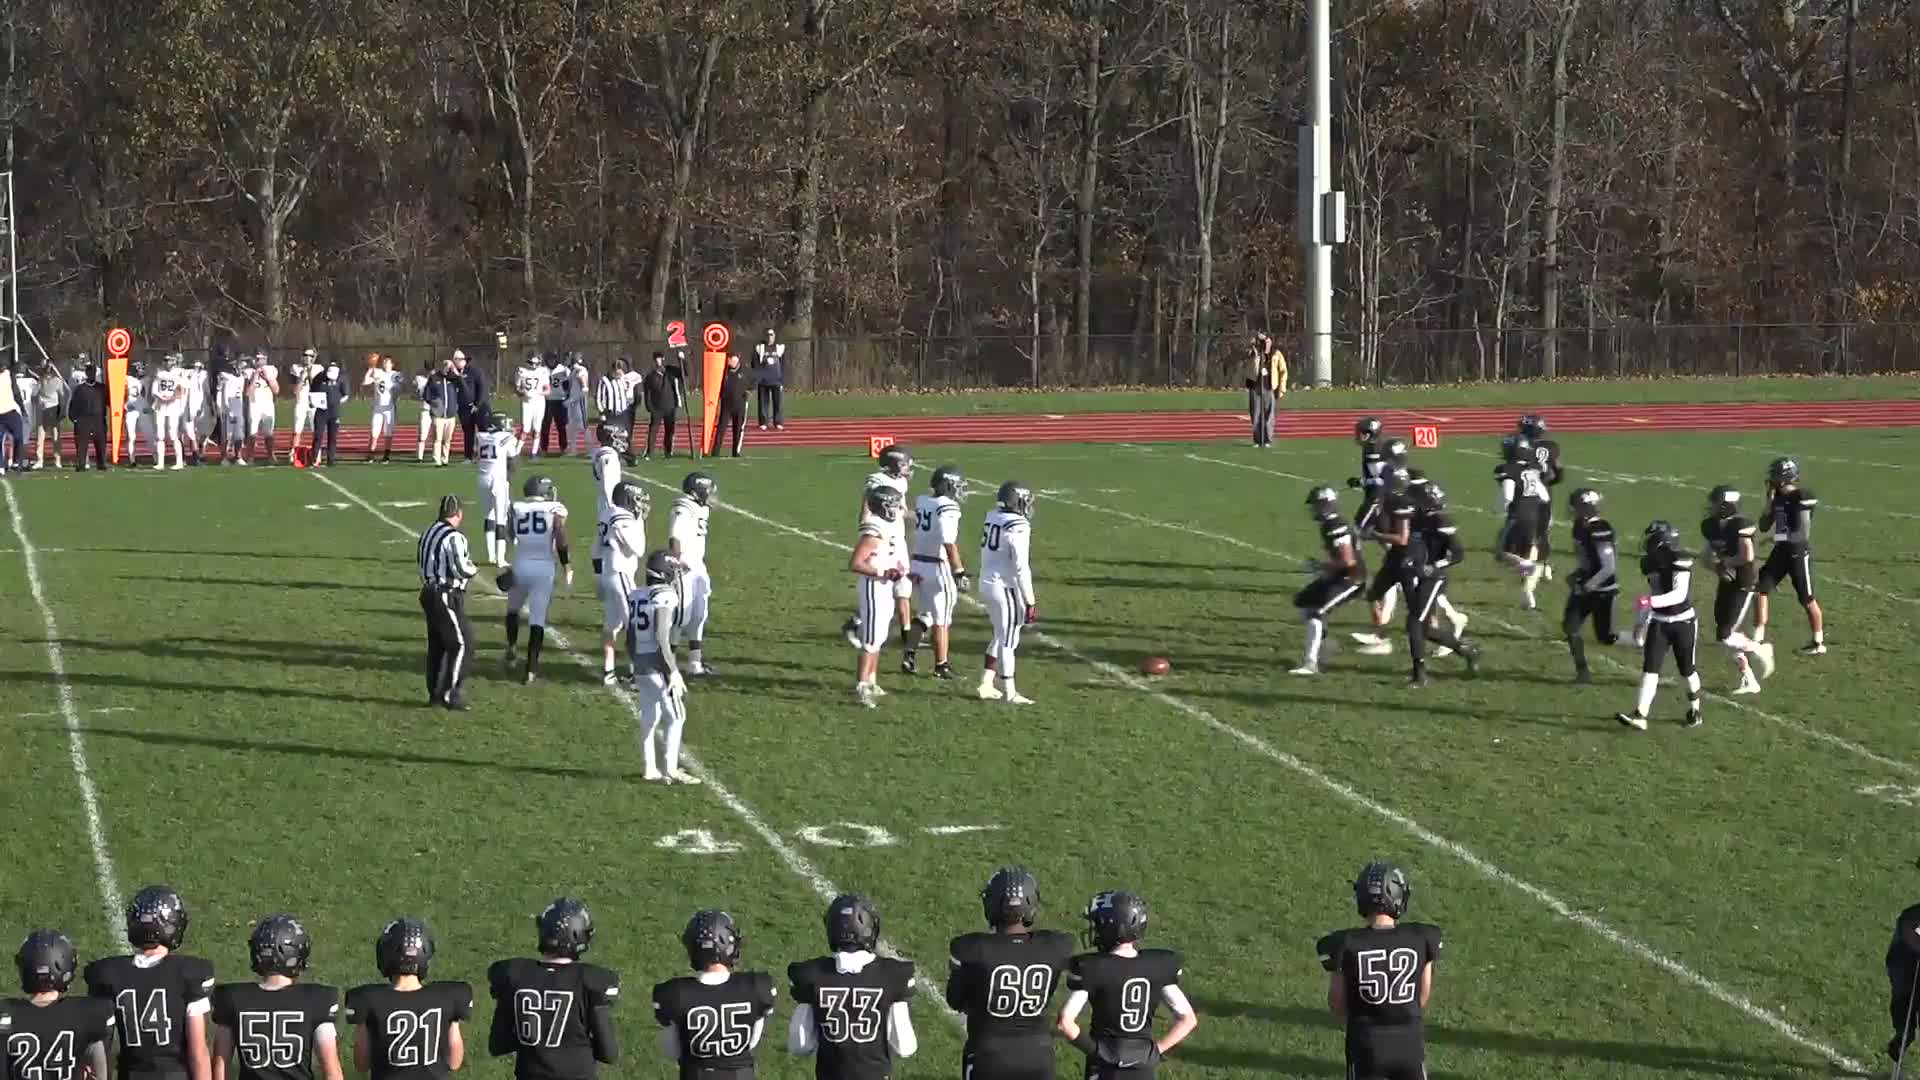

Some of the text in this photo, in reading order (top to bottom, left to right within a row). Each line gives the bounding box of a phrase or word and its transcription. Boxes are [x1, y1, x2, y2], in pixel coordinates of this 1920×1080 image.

[667, 320, 687, 346] 2
[525, 377, 539, 391] 57
[1418, 428, 1434, 446] 20
[516, 510, 548, 534] 26
[986, 963, 1052, 1018] 69
[1357, 947, 1418, 1006] 52
[115, 988, 172, 1047] 14
[513, 988, 574, 1048] 67
[687, 1002, 752, 1057] 25
[818, 986, 884, 1043] 33
[1120, 977, 1151, 1033] 9
[7, 1030, 76, 1080] 24
[239, 1010, 304, 1069] 55
[386, 1007, 442, 1067] 21
